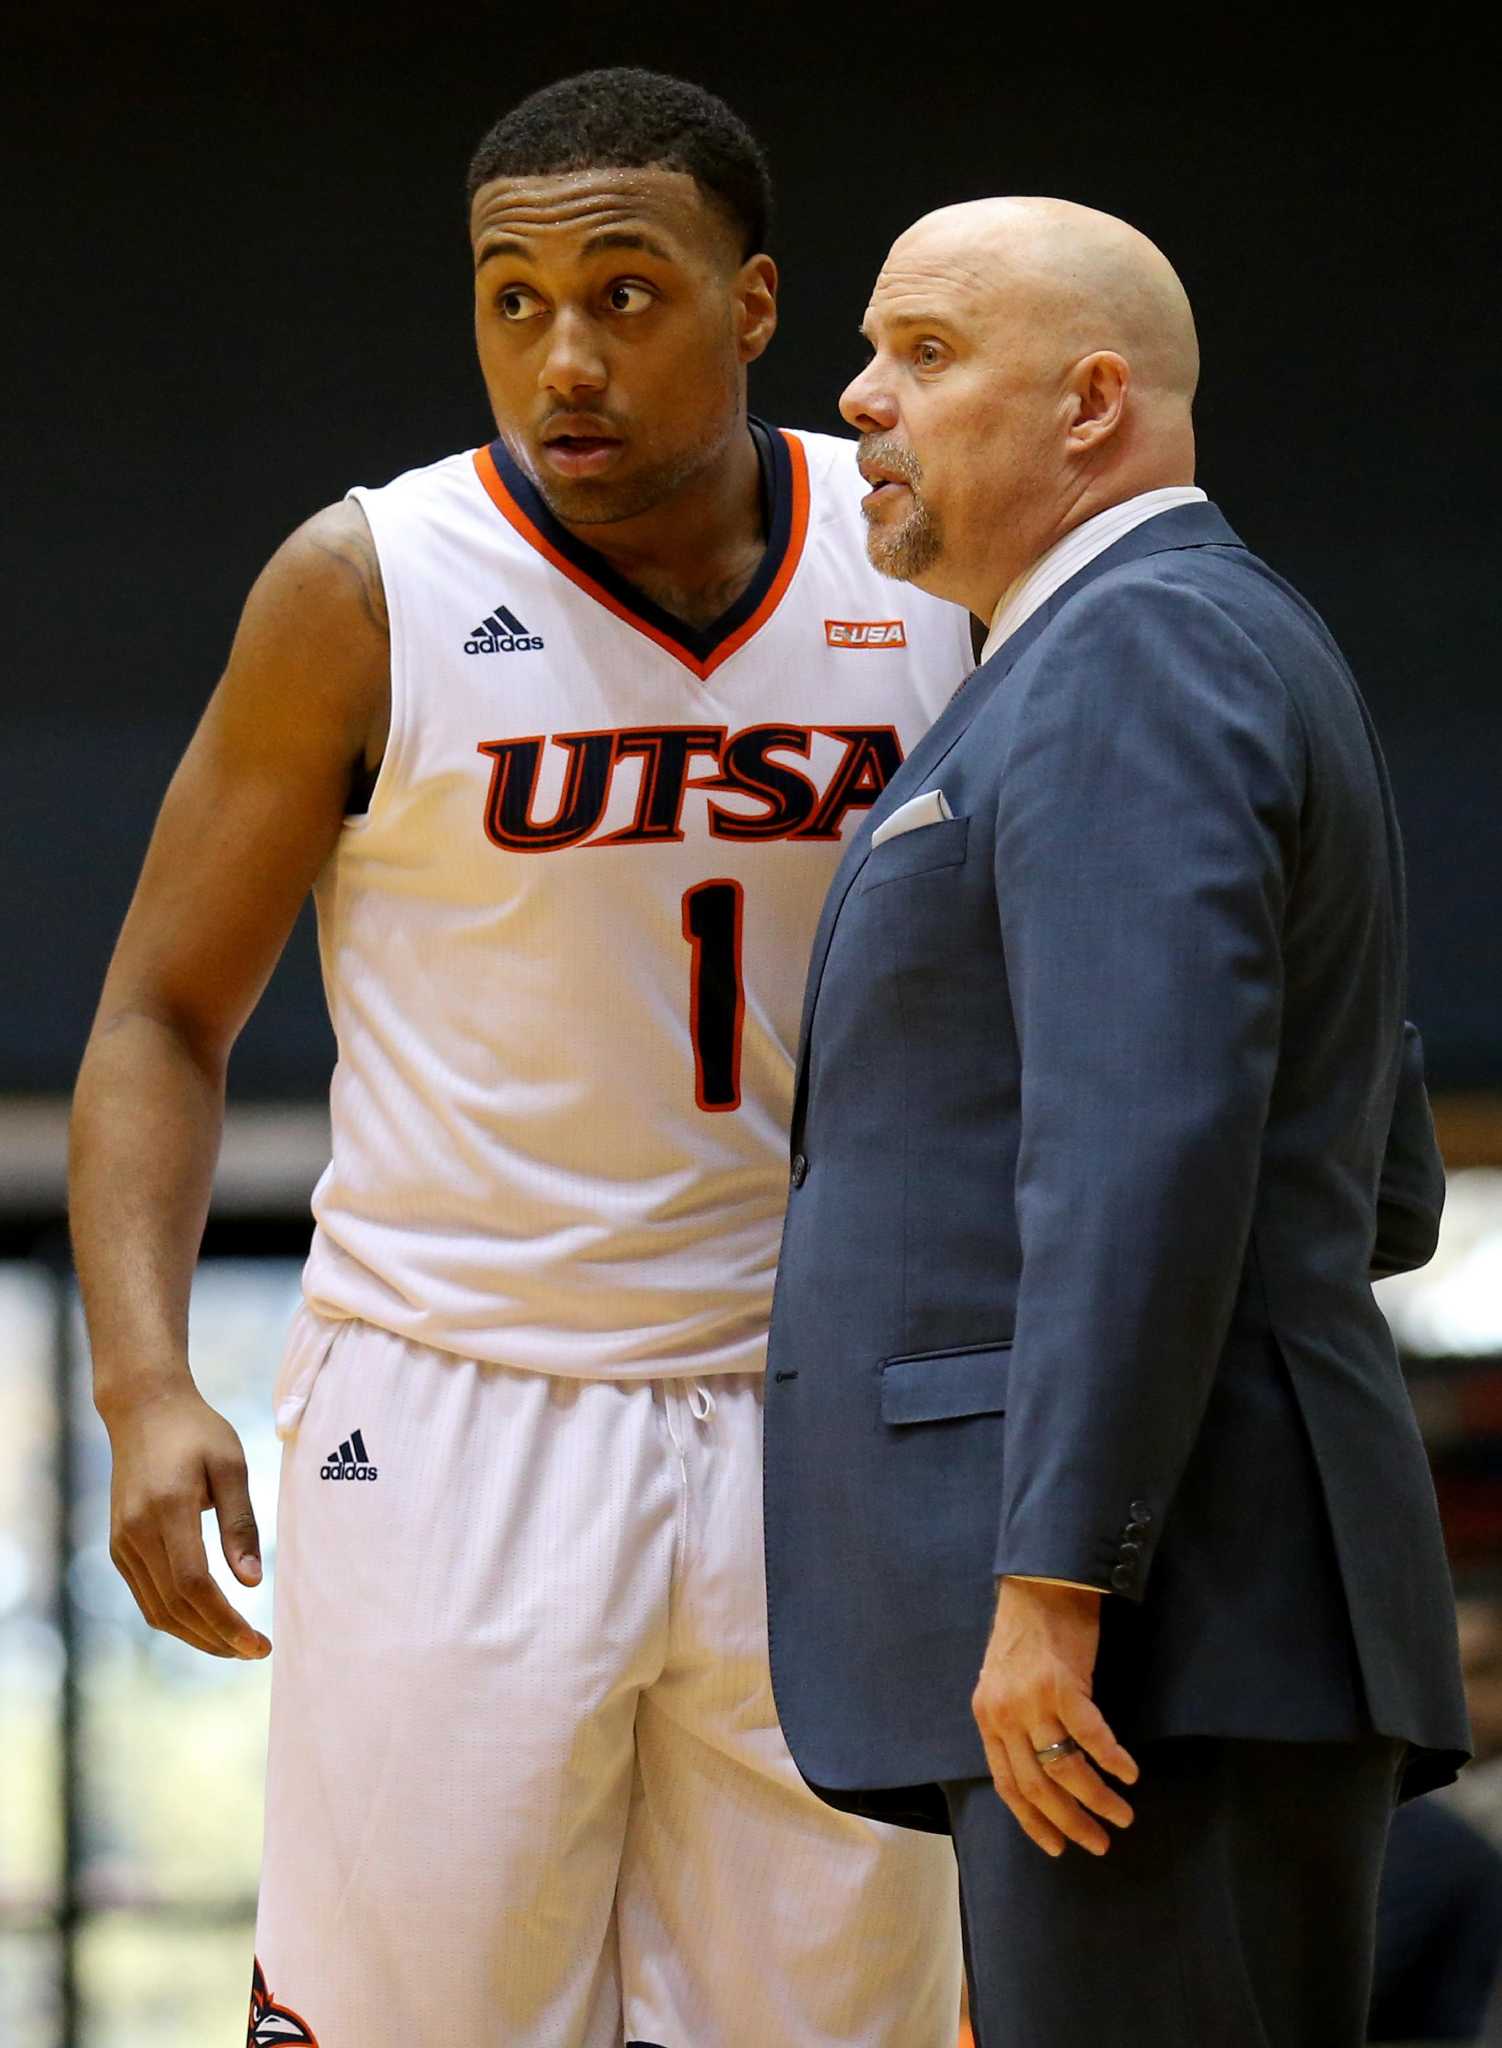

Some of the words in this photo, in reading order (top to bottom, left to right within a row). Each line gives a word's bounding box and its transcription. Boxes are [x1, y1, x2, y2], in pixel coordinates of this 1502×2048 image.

[464, 634, 544, 655] adidas
[477, 723, 905, 853] UTSA
[681, 878, 746, 1112] 1
[320, 1461, 378, 1481] adidas
